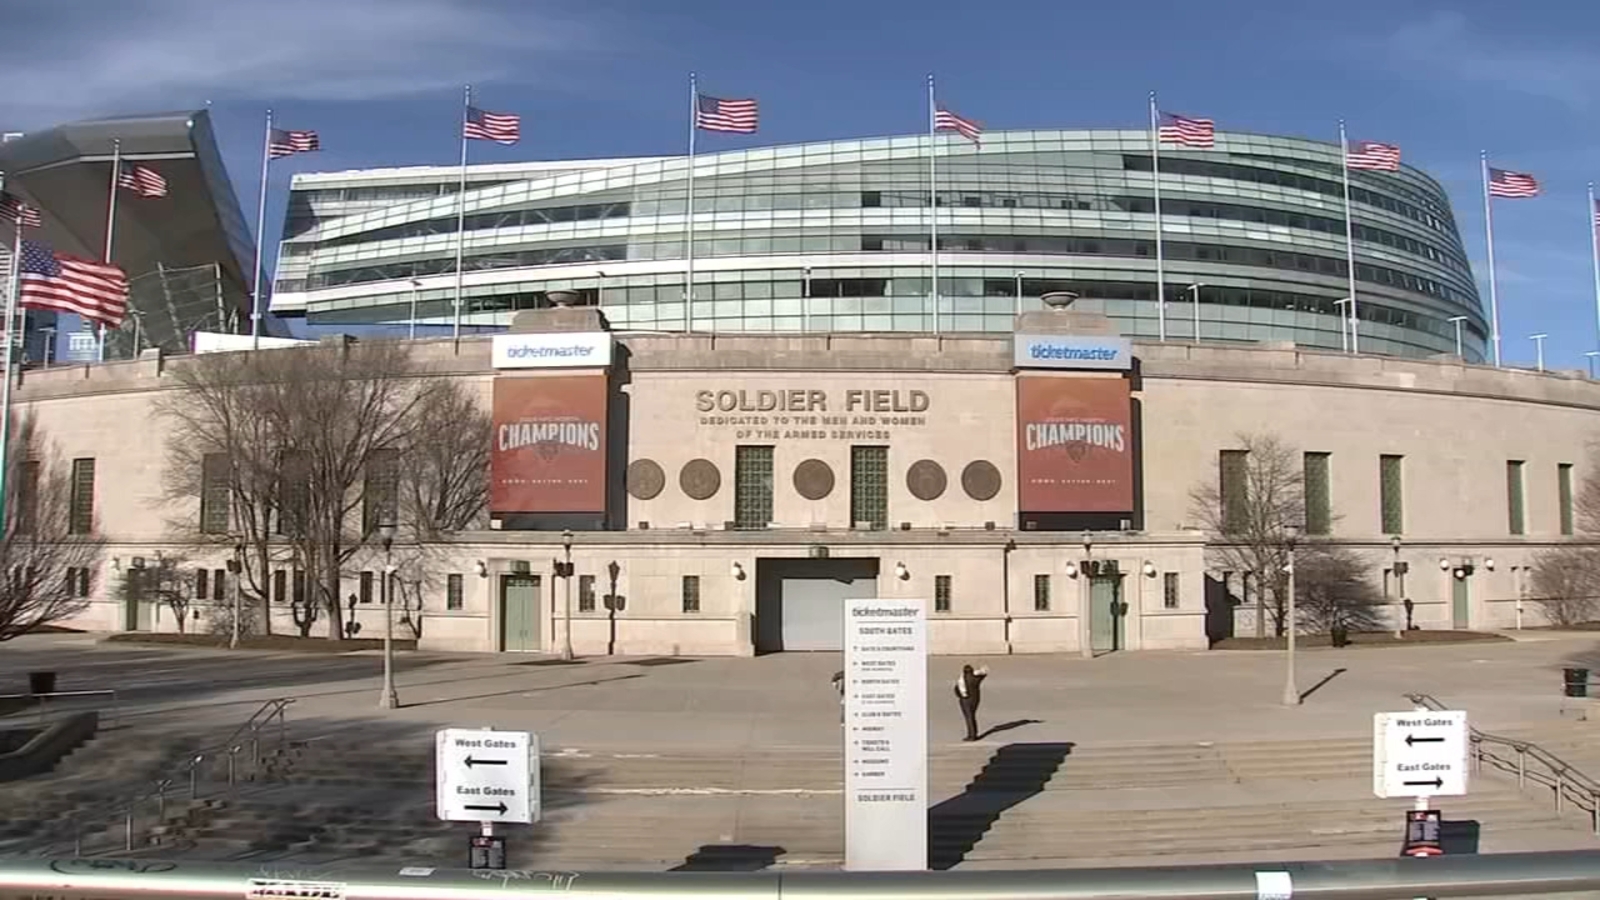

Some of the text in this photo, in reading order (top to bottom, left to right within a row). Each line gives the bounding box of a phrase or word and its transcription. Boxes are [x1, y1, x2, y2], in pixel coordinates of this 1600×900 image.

[507, 344, 594, 359] ticketmaster
[1030, 345, 1118, 361] ticketmaster
[696, 389, 930, 412] SOLDIER FIELD
[700, 416, 926, 426] DEDICATED TO THE MEN AND WOMEN
[499, 422, 600, 451] CHAMPIONS
[736, 430, 890, 440] OF THE ARMED SERVICES
[1026, 423, 1124, 452] CHAMPIONS
[852, 607, 920, 617] ticketmaster
[859, 627, 913, 635] SOUTH GATES
[455, 739, 516, 748] West Gates
[1422, 763, 1451, 771] Gates
[456, 786, 515, 796] East Gates
